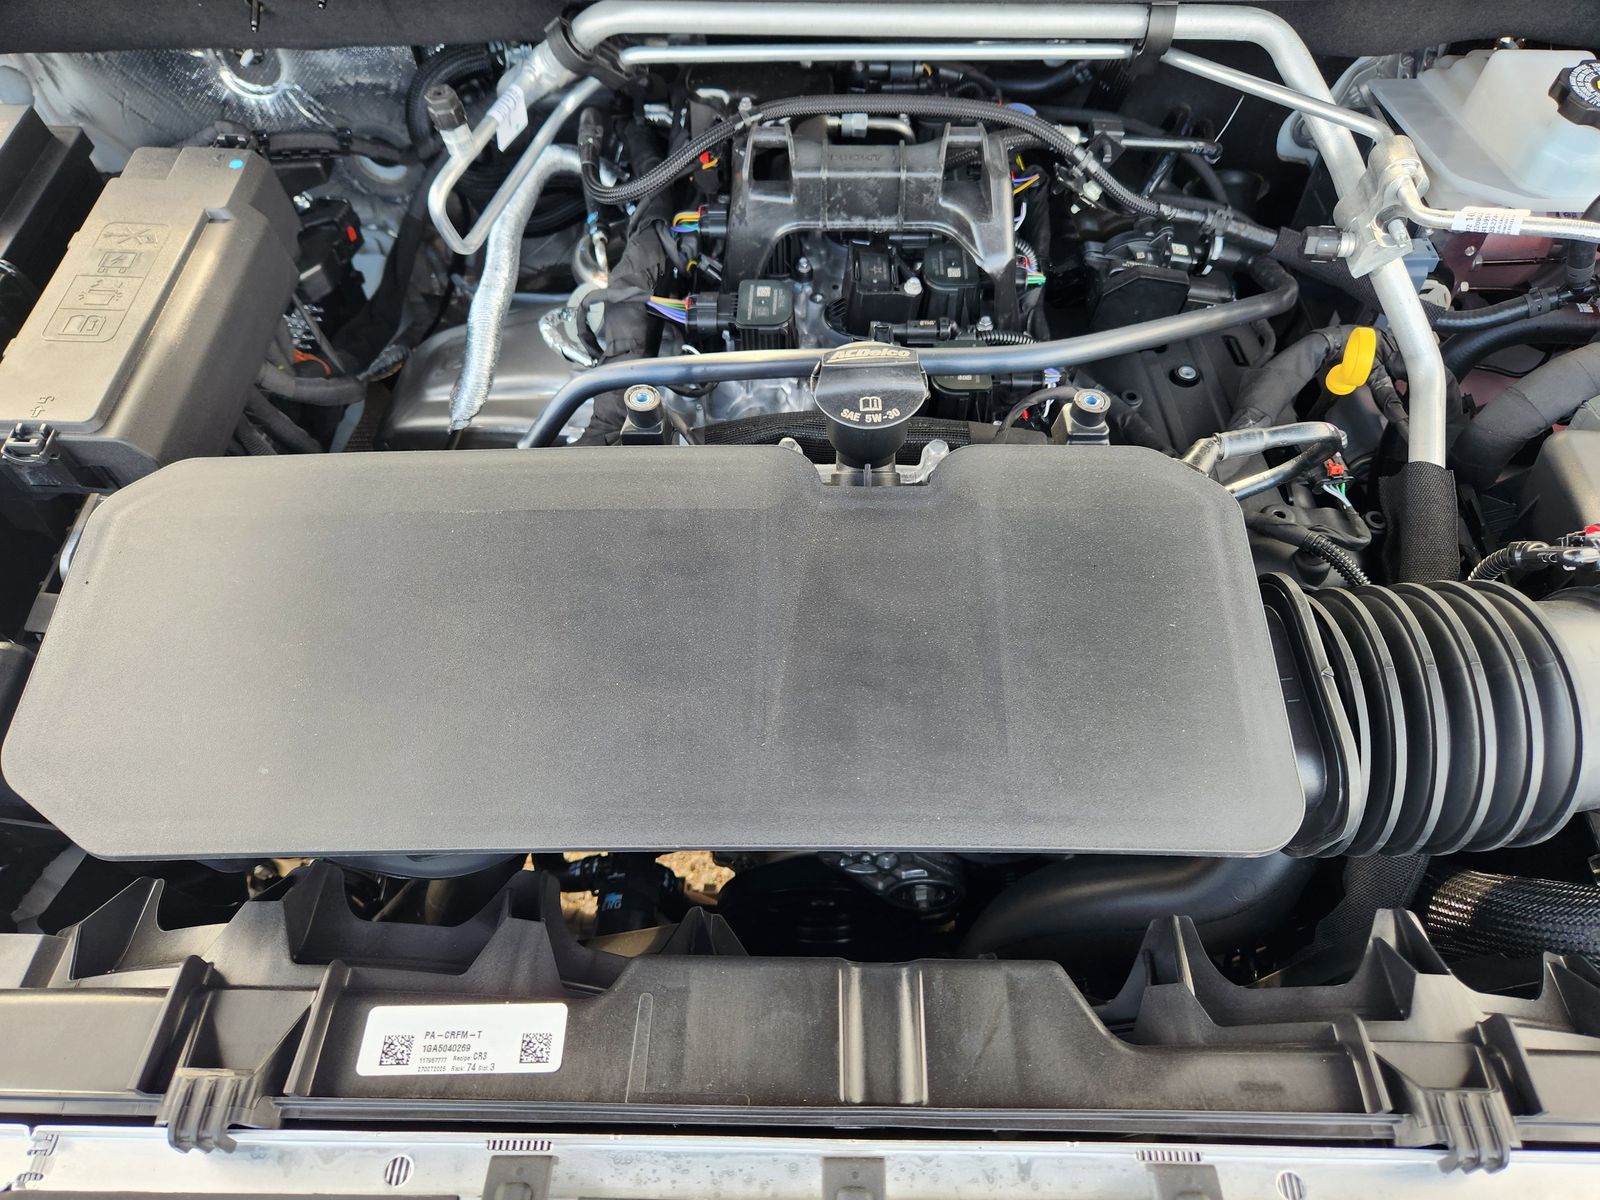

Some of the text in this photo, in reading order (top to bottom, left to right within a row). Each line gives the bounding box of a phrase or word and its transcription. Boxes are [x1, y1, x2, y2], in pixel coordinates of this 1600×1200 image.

[828, 348, 911, 360] ACDelco
[840, 408, 901, 423] SAE 5W-30
[473, 1051, 488, 1061] CR3
[467, 1062, 477, 1072] 74
[489, 1062, 496, 1072] 3
